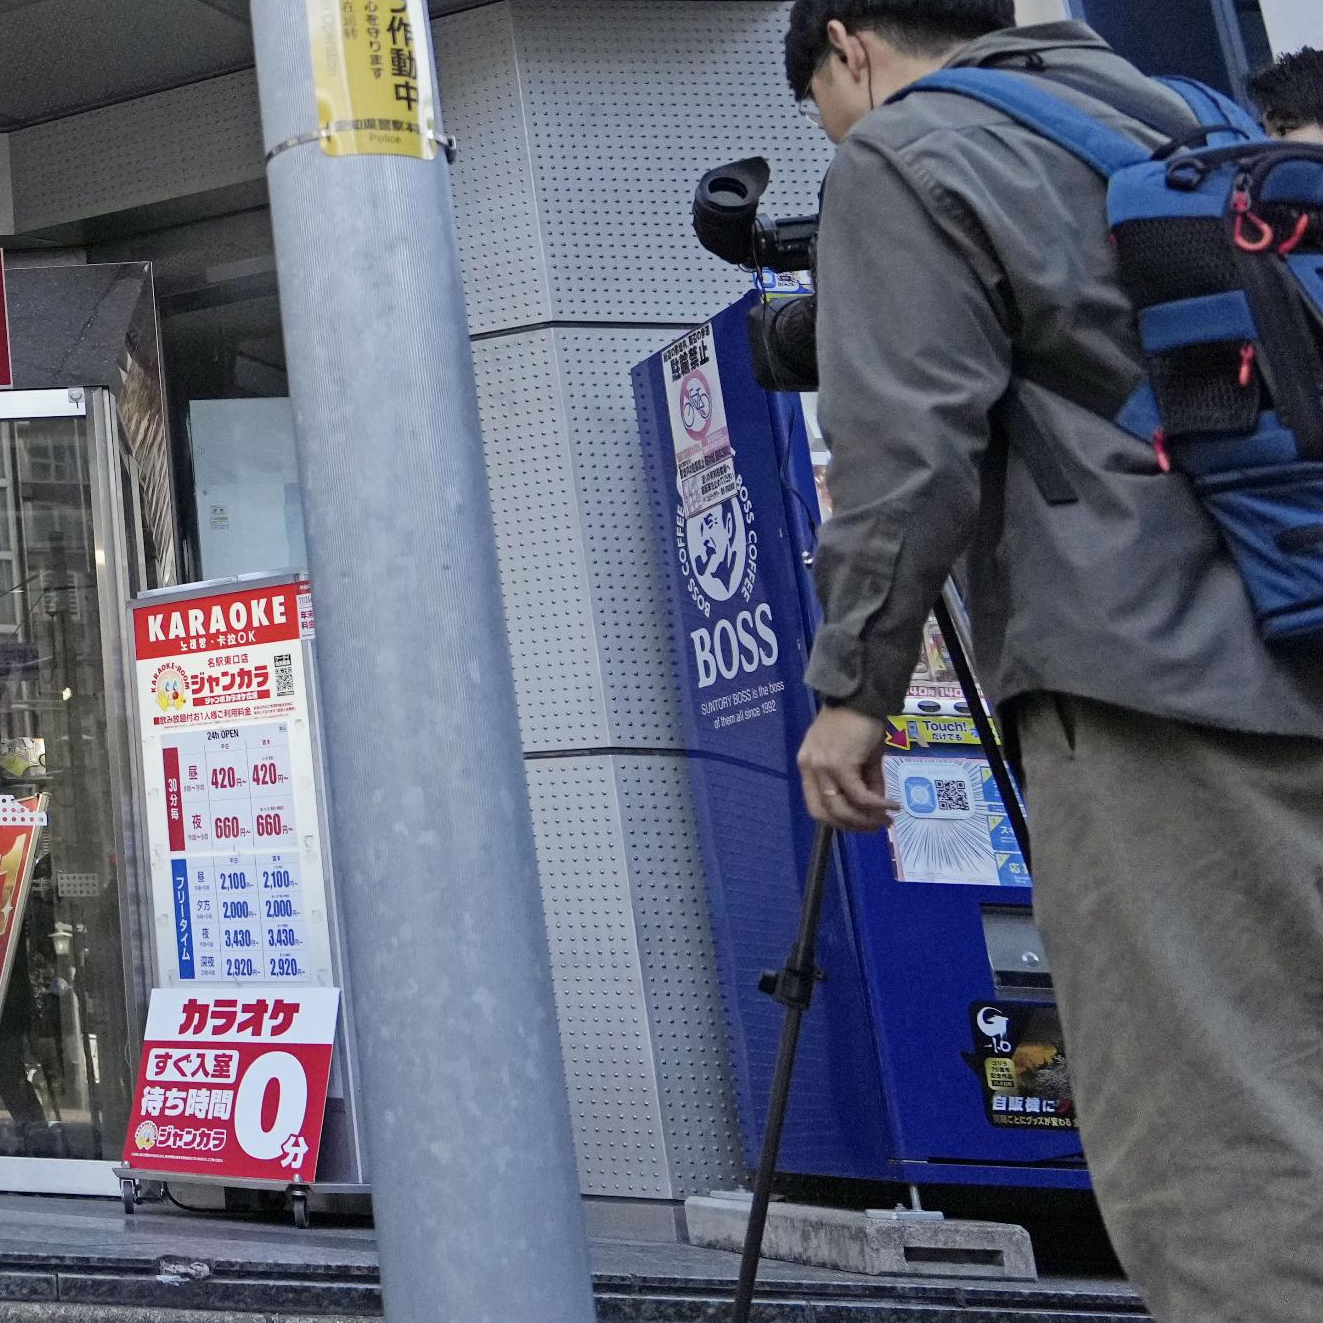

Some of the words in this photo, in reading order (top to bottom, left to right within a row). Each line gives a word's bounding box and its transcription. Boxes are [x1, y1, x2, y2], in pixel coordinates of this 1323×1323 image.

[676, 504, 691, 576] COFFEE
[741, 529, 758, 603] COFFEE
[687, 578, 711, 619] BOSS
[147, 595, 287, 643] KARAOKE
[690, 602, 779, 689] BOSS
[207, 653, 249, 668] 名駅東口店
[190, 664, 269, 695] ジャンカラ
[701, 695, 733, 716] SUNTORY
[733, 688, 752, 705] BOSS
[761, 699, 777, 715] 1992
[206, 731, 220, 741] 24h
[220, 728, 239, 739] OPEN
[922, 719, 968, 733] Touch!
[931, 732, 964, 742] だけでも
[191, 814, 203, 830] 夜
[175, 877, 191, 961] フリータイム
[196, 899, 211, 911] 夕方
[202, 928, 210, 940] 夜
[200, 956, 215, 968] 深夜
[178, 998, 300, 1037] カラオケ
[154, 1052, 233, 1079] すぐ入室
[140, 1085, 235, 1120] 待ち時間
[234, 1050, 308, 1160] 0
[156, 1125, 227, 1152] ジャンカラ
[279, 1135, 309, 1169] 分
